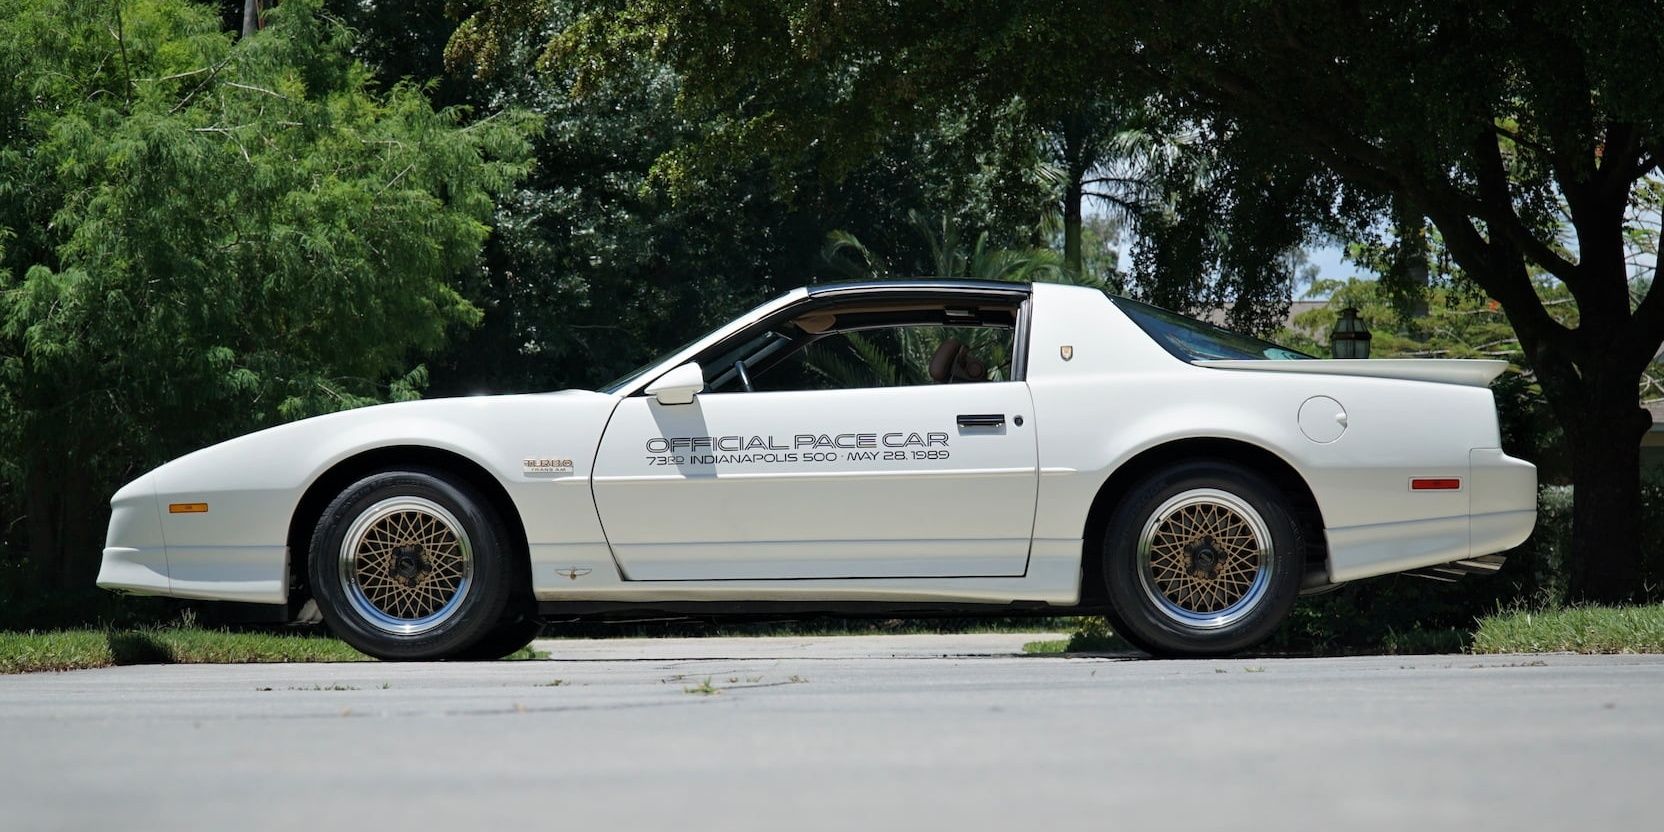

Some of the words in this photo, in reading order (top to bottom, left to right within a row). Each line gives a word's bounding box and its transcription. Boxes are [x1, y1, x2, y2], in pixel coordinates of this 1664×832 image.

[646, 435, 790, 454] OFFICIAL
[794, 433, 877, 449] PACE
[882, 432, 950, 447] CAR
[690, 453, 798, 465] INDIANAPOLIS
[803, 452, 837, 462] 500
[847, 451, 880, 461] MAY
